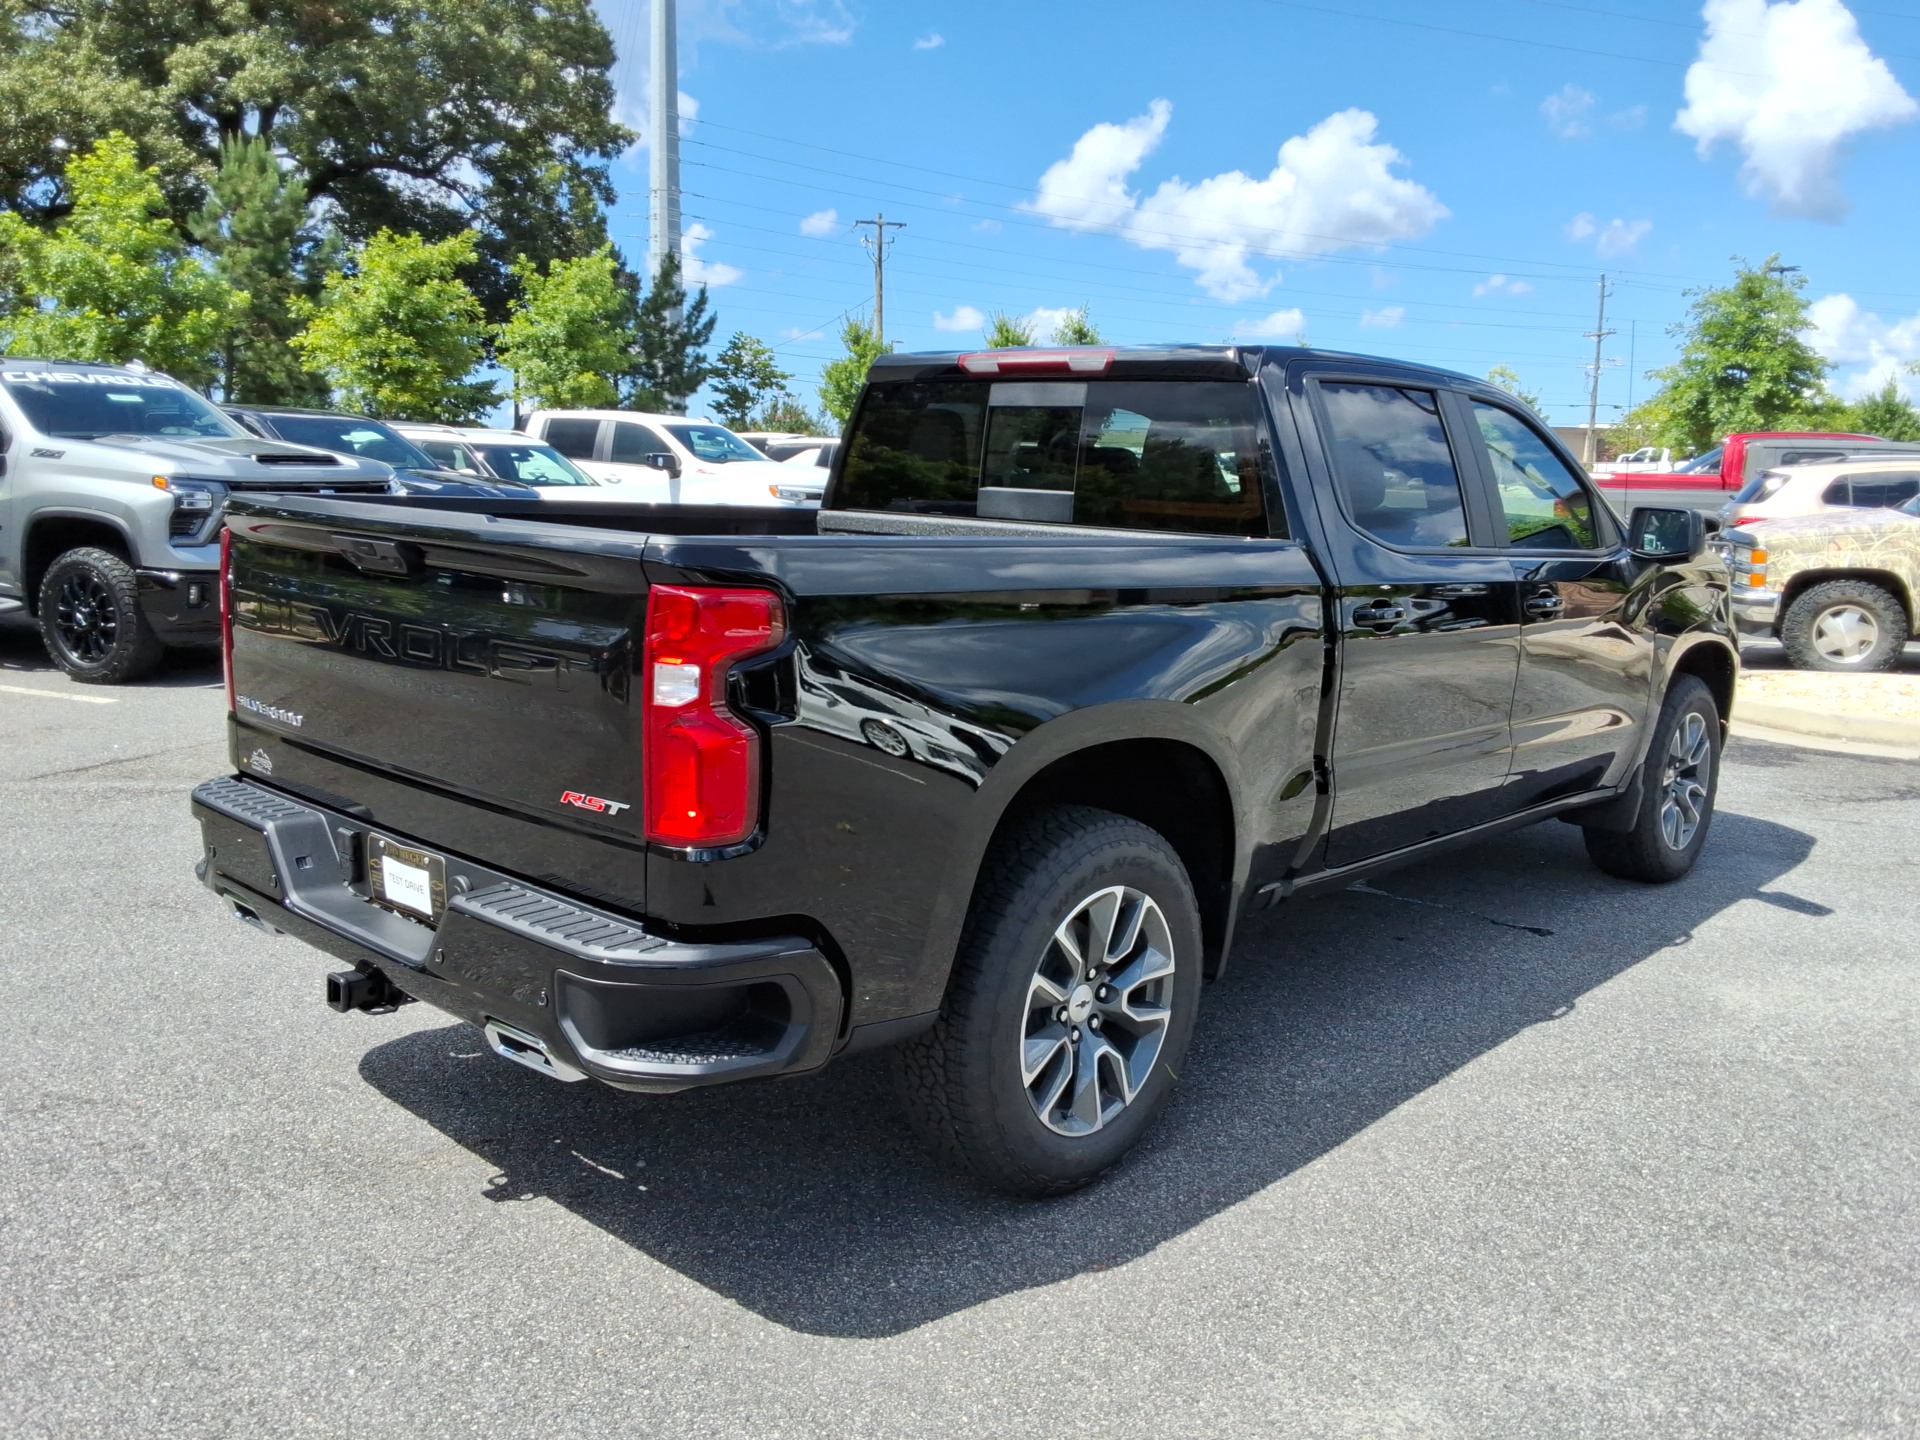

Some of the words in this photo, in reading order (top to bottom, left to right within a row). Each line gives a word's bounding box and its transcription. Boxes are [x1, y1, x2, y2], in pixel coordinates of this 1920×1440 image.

[2, 371, 181, 389] CHEVROLET
[560, 790, 631, 815] RST
[388, 872, 403, 886] TEST
[404, 879, 425, 895] DRIVE
